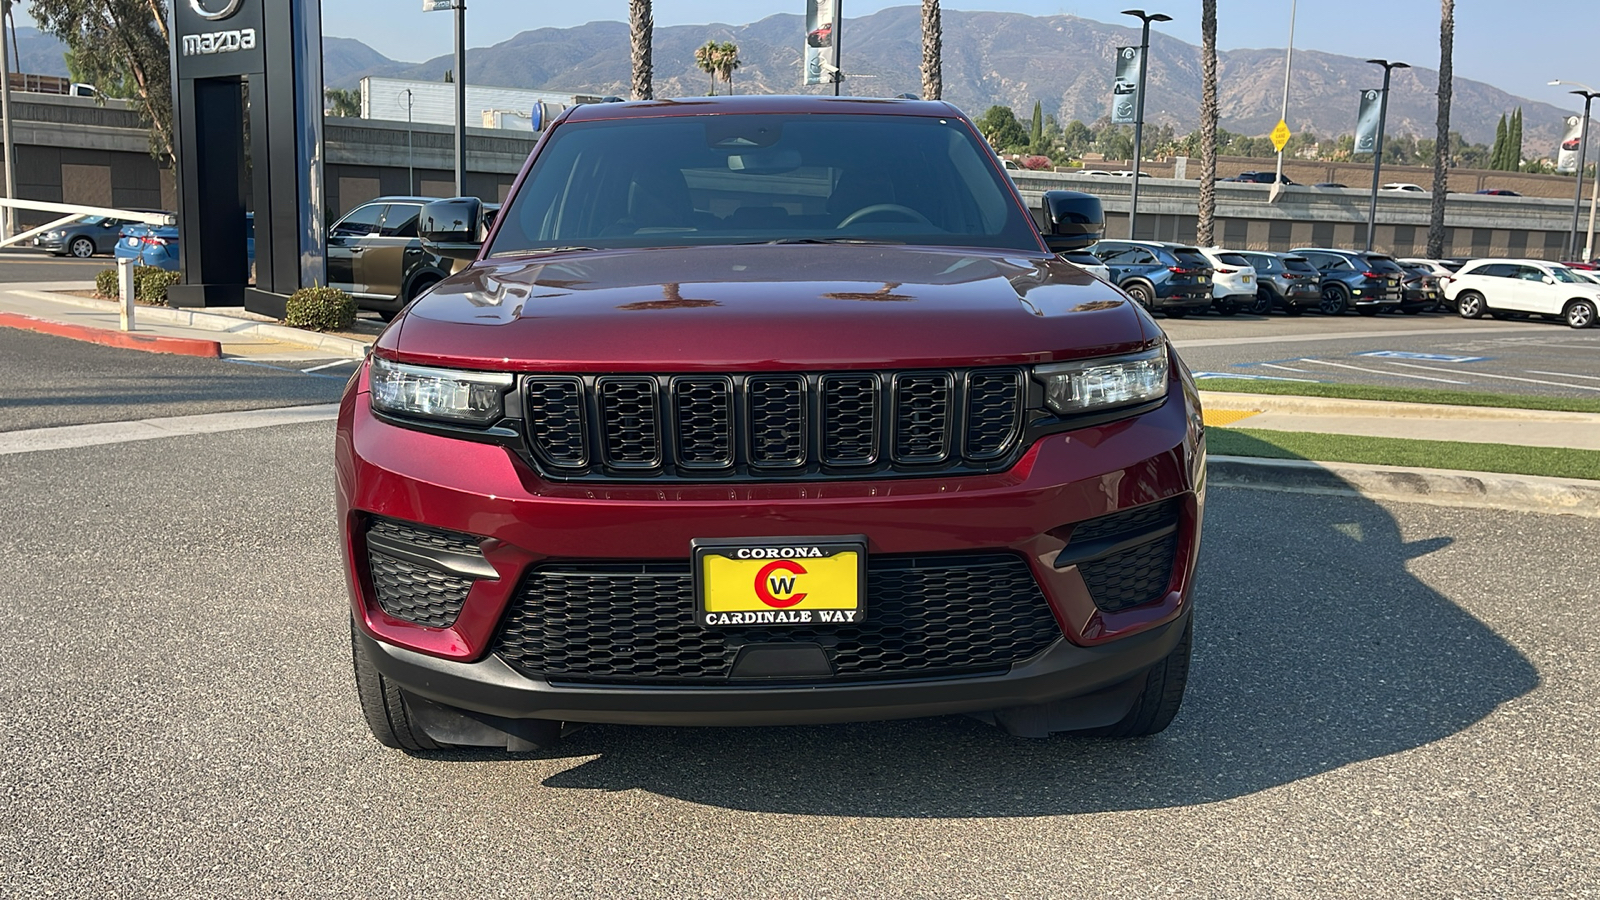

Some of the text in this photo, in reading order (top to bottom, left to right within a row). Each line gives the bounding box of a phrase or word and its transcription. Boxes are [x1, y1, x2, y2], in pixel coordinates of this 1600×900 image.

[737, 547, 823, 559] CORONA
[705, 610, 857, 625] CARDINALE WAY
